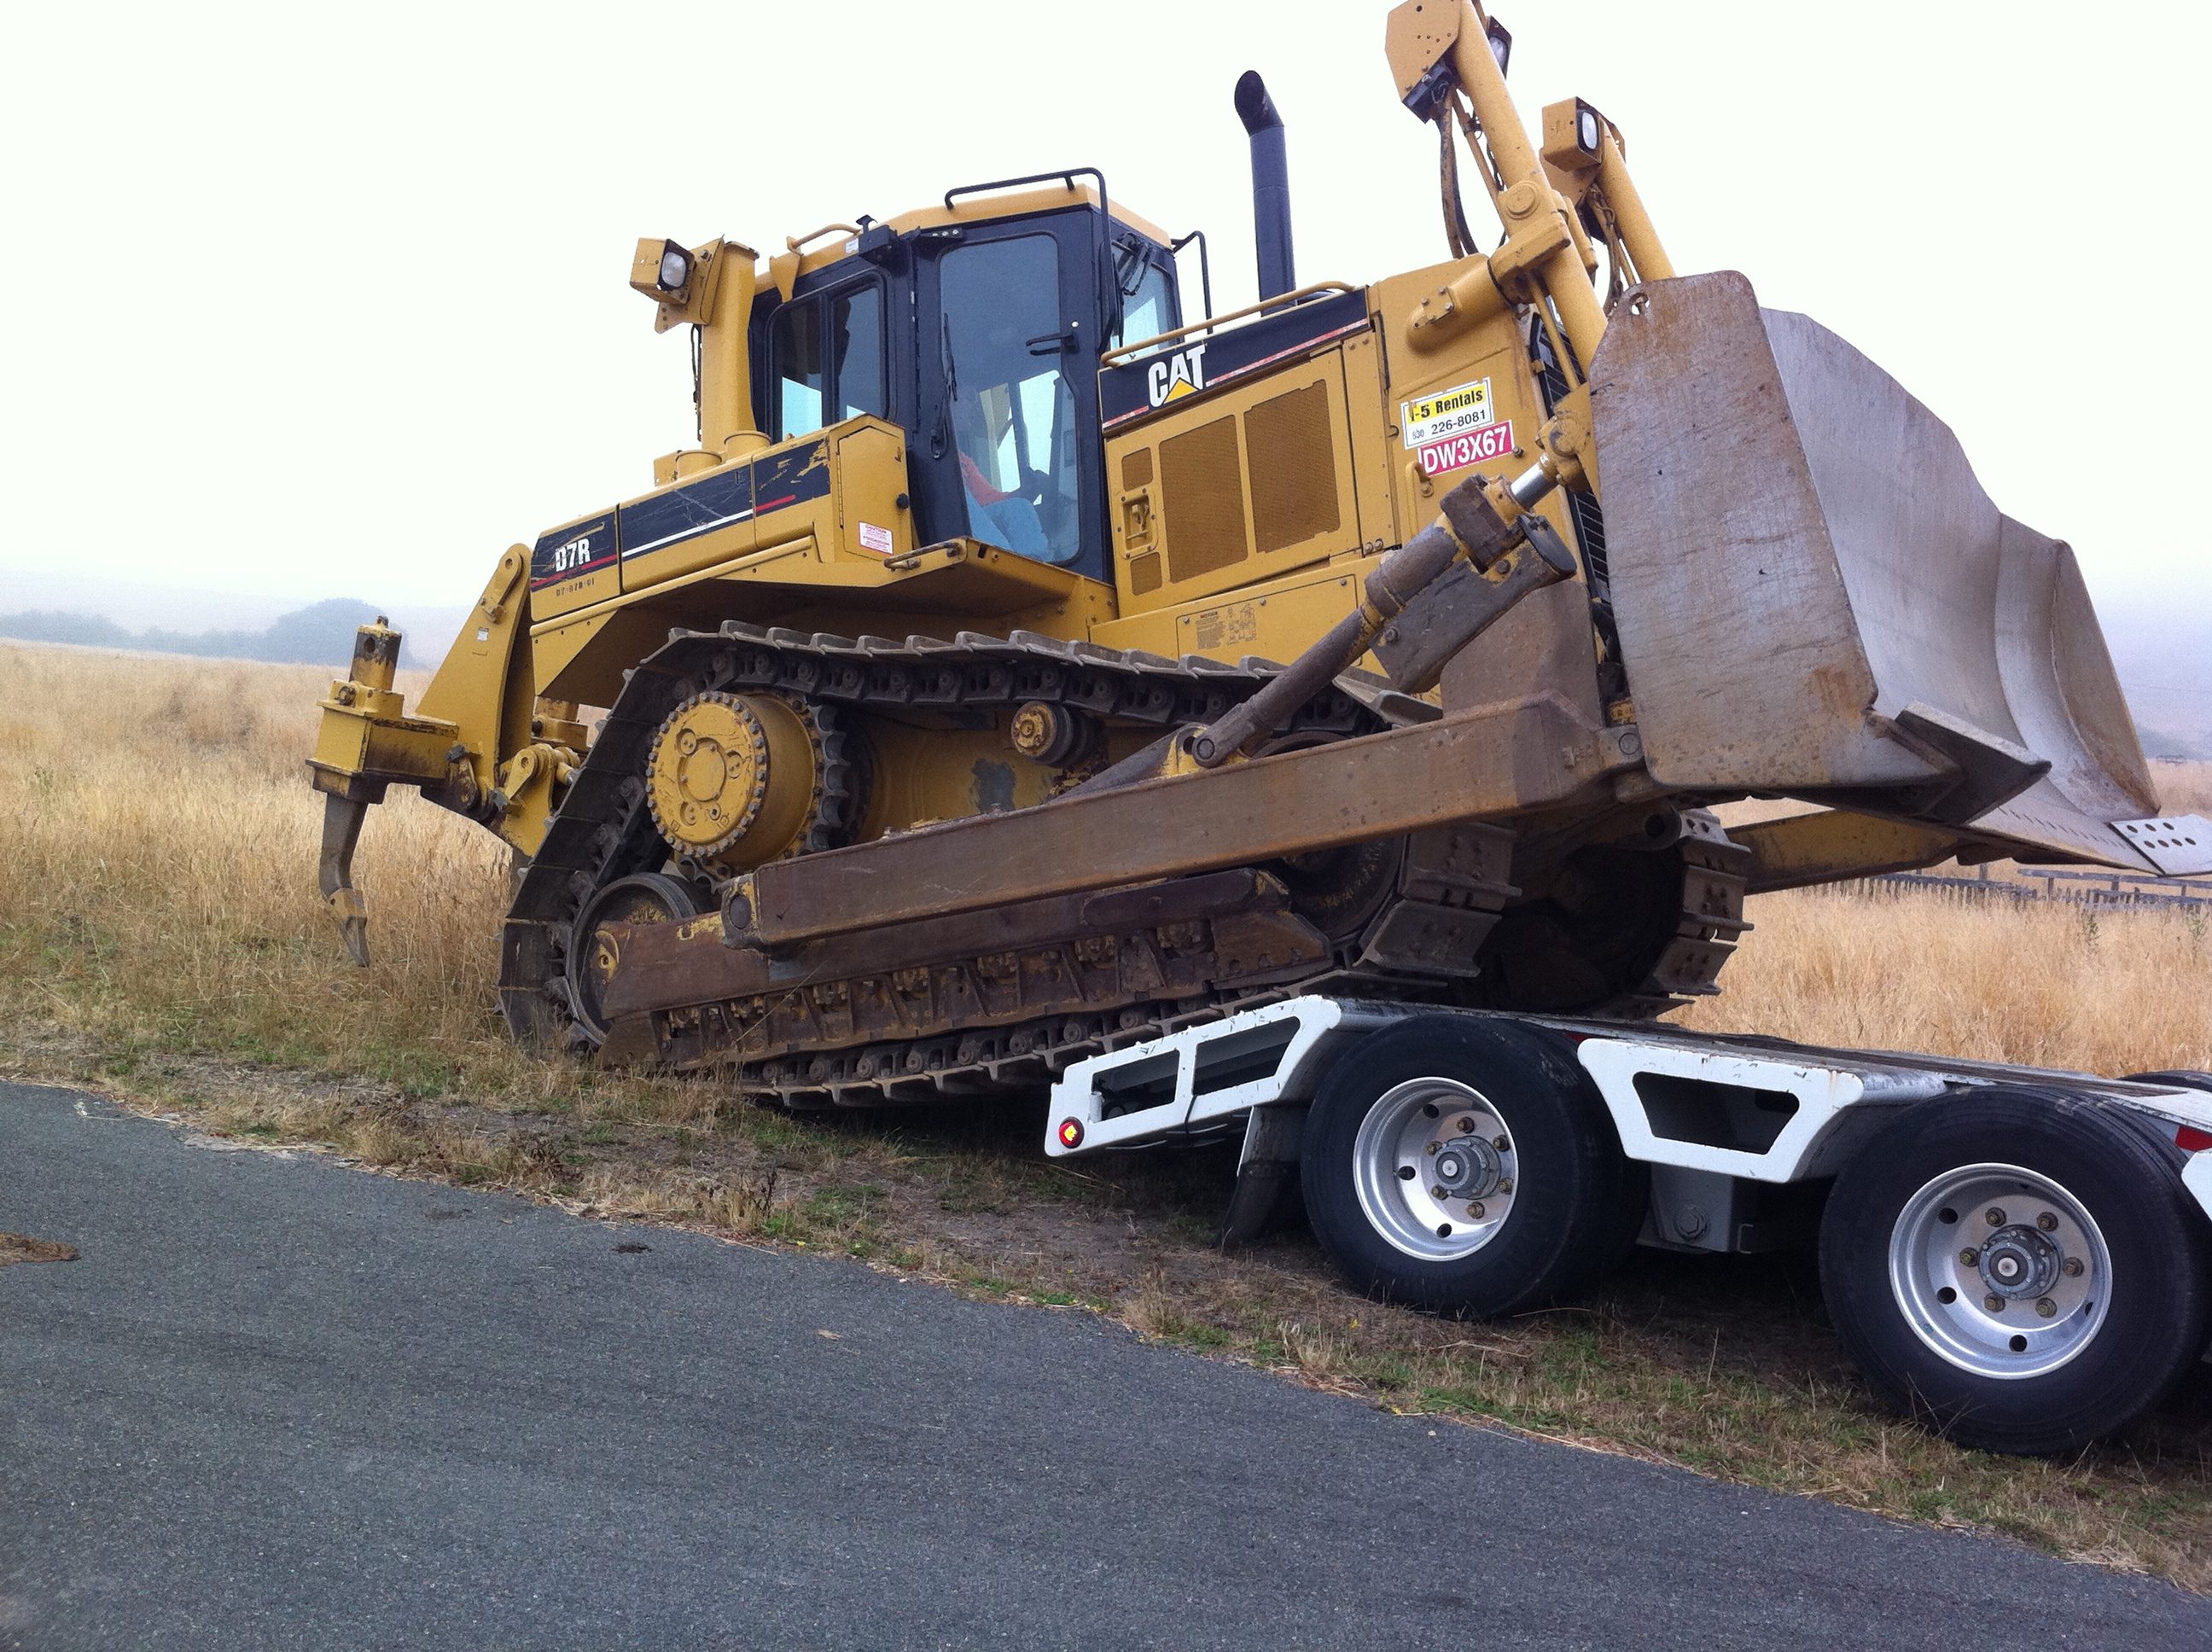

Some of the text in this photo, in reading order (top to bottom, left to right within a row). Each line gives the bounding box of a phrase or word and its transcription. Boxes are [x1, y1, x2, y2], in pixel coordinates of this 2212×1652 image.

[1148, 344, 1206, 408] CAT
[1435, 390, 1483, 414] Rentals
[1431, 410, 1486, 435] 226-8081
[1423, 426, 1507, 473] DW3X67
[555, 538, 591, 573] D7R
